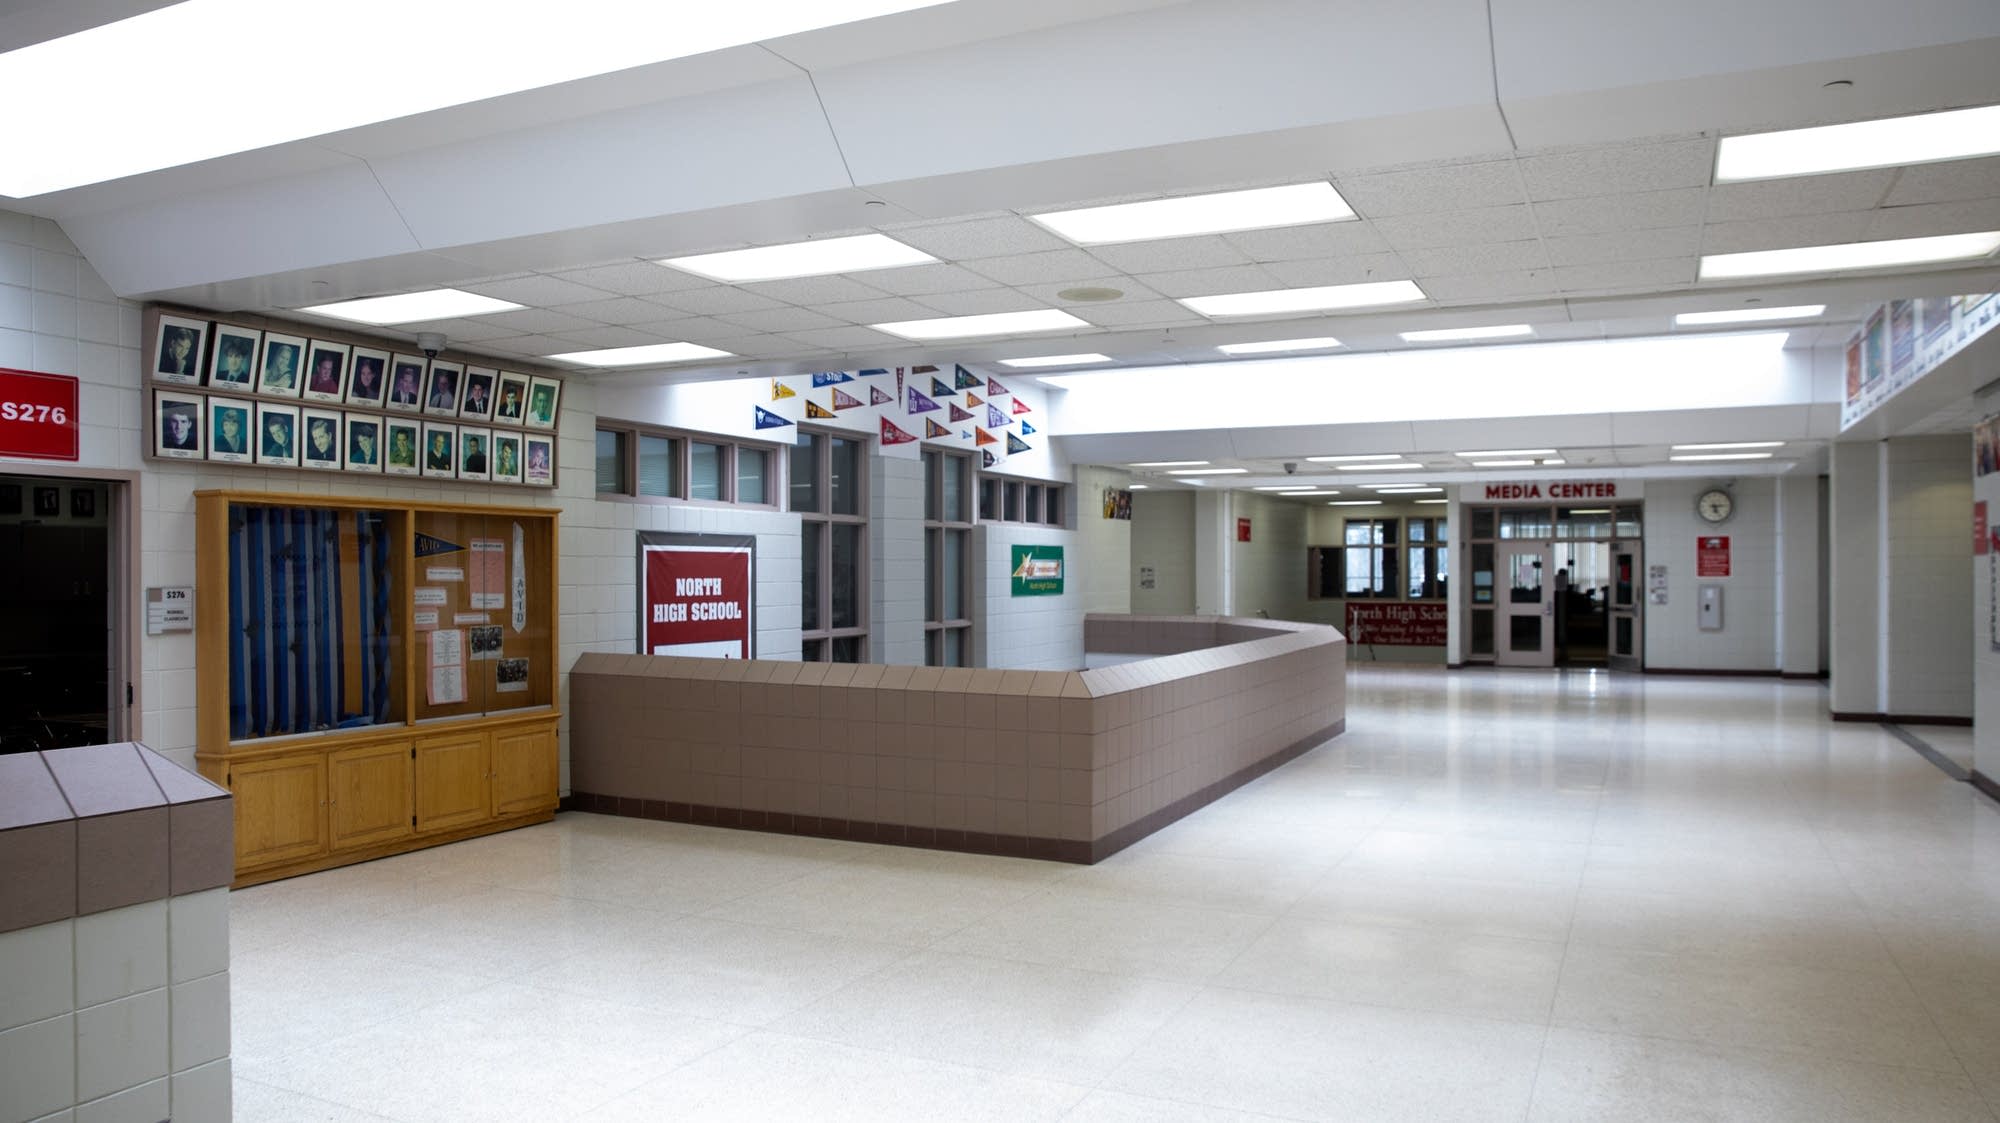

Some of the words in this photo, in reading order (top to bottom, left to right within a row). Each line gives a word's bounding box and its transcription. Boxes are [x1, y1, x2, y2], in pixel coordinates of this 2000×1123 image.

[1, 401, 66, 425] S276
[1485, 484, 1542, 499] MEDIA
[1548, 482, 1616, 498] CENTER
[419, 538, 440, 552] AVID
[166, 590, 185, 599] S276
[675, 577, 722, 597] NORTH
[516, 578, 525, 624] AVID
[653, 603, 687, 623] HIGH
[691, 601, 742, 621] SCHOOL
[1386, 606, 1415, 623] High
